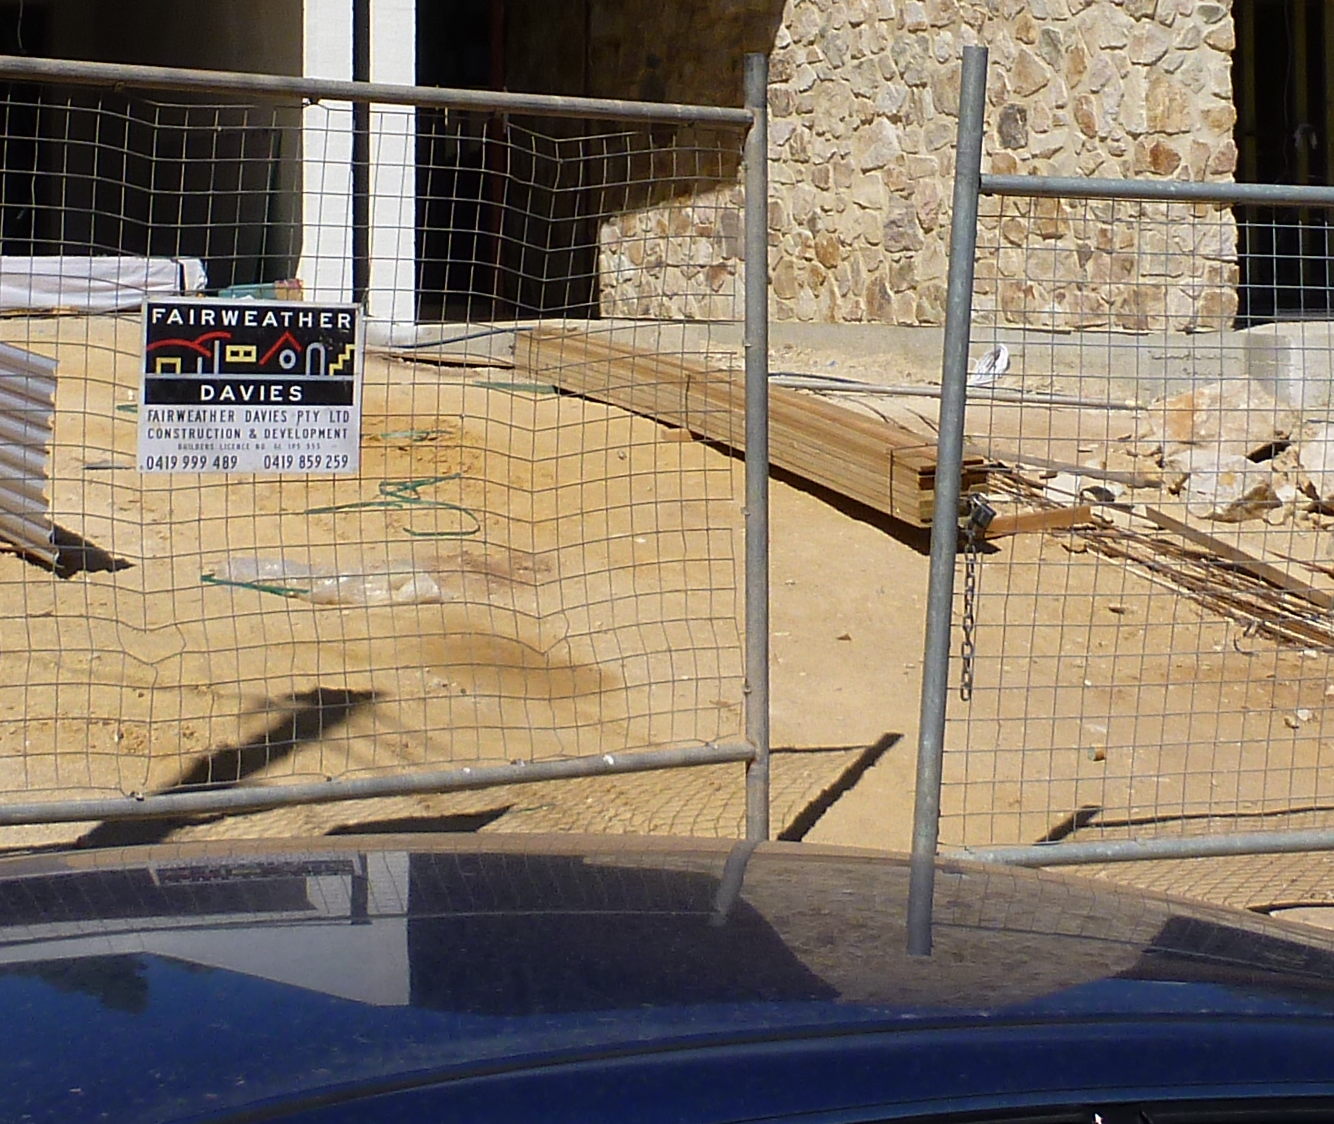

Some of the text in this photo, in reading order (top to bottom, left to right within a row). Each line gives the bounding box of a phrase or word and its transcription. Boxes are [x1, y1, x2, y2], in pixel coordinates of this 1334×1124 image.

[151, 308, 352, 328] FAIRWEATHER
[200, 385, 303, 401] DAVIES
[148, 409, 350, 423] FAIRWEATHER DAVIES PTY LTD
[148, 428, 348, 439] CONSTRUCTION & DEVELOPMENT
[146, 454, 349, 470] 0419 999 489 0419 859 259
